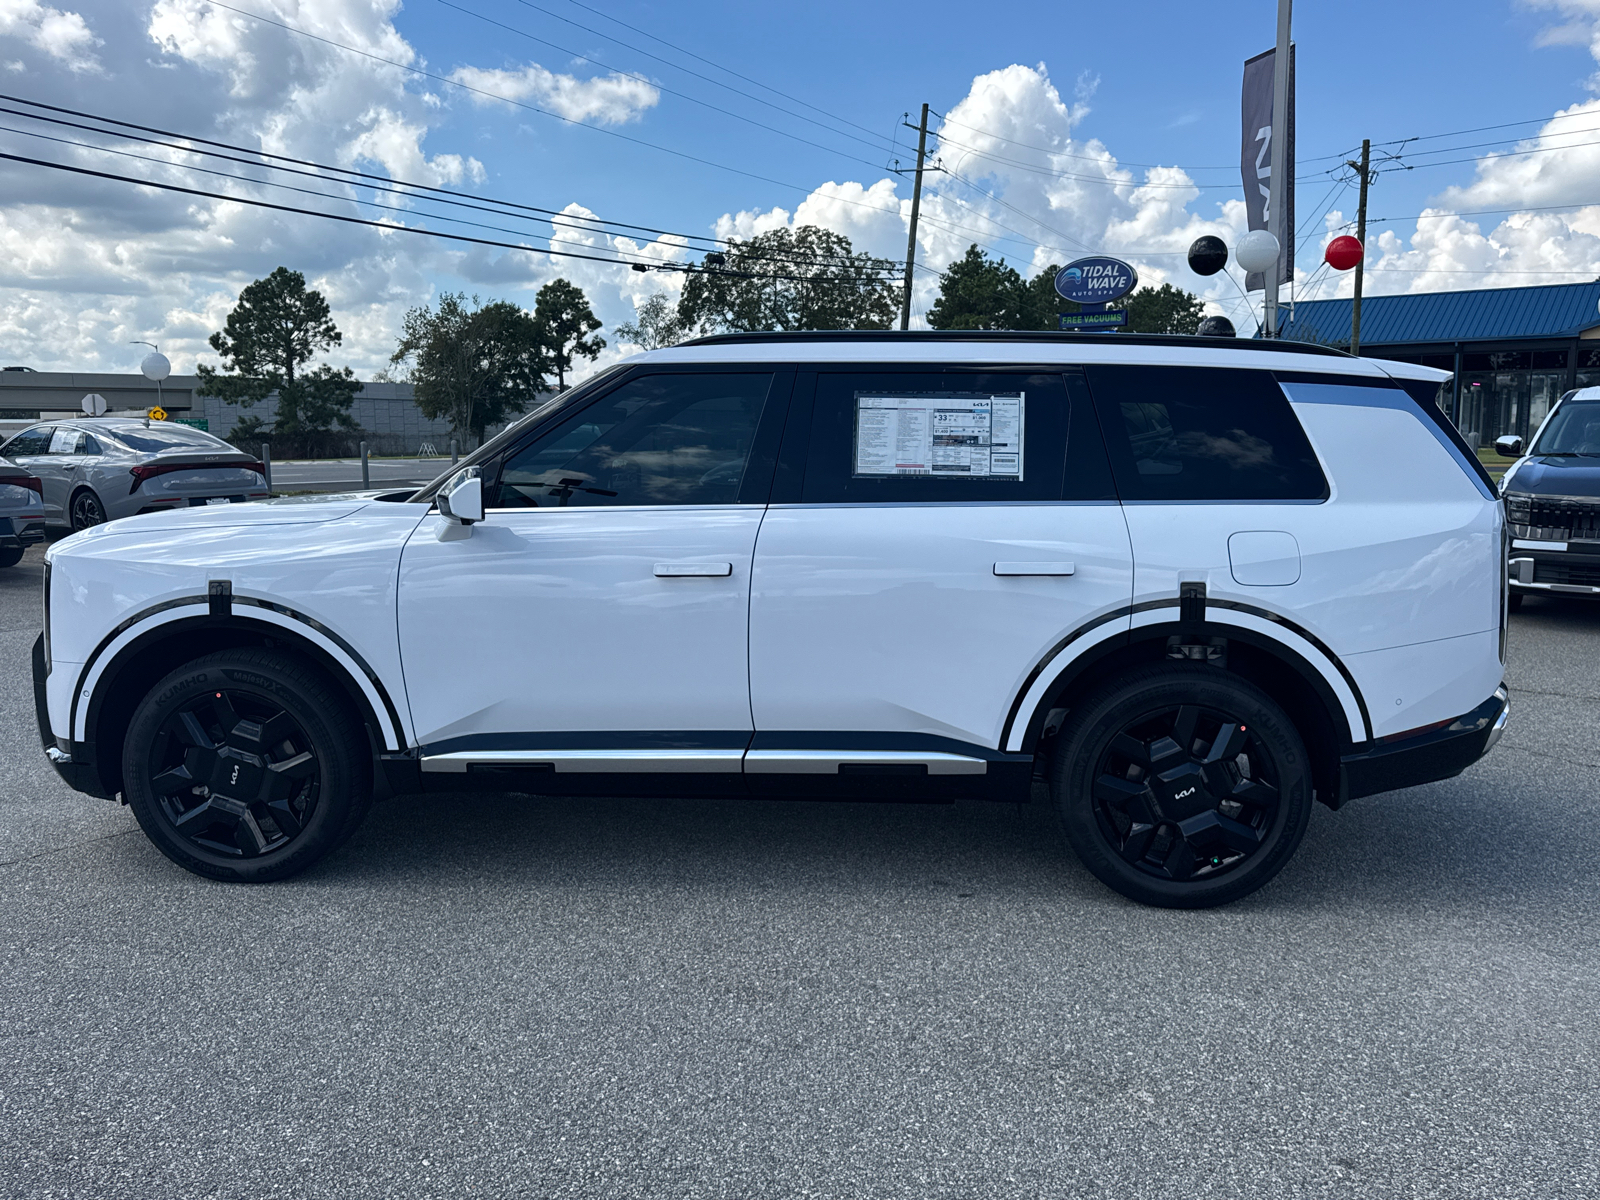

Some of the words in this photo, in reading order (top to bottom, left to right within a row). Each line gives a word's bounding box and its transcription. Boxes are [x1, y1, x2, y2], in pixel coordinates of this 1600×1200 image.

[1083, 265, 1119, 277] TIDAL
[1087, 276, 1126, 289] WAVE
[1061, 315, 1082, 324] FREE
[1084, 313, 1122, 323] VACUUMS
[154, 673, 208, 708] KUMHO
[1252, 708, 1297, 765] KUMHO
